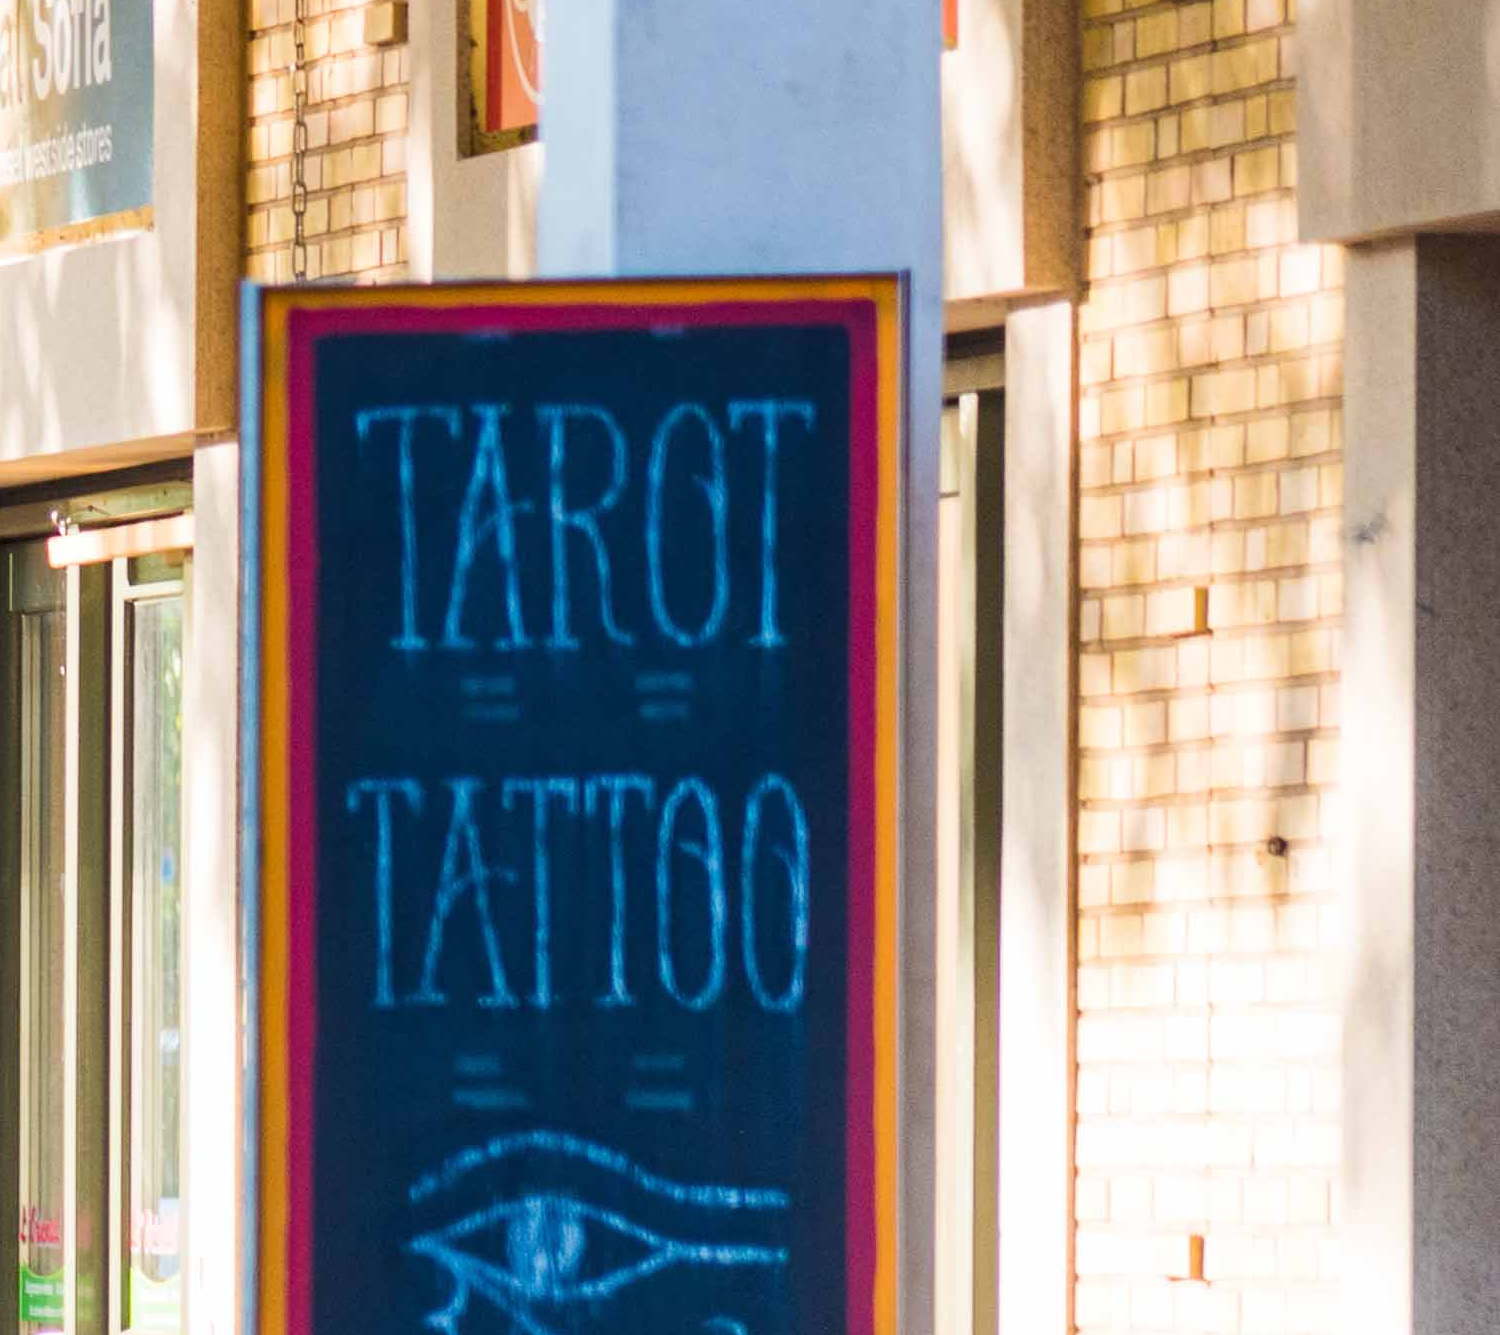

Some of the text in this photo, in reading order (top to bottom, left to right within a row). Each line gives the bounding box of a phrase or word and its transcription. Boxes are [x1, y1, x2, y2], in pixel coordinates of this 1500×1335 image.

[76, 121, 113, 169] stores
[355, 398, 816, 650] TAROT
[347, 773, 810, 1013] TATTOO
